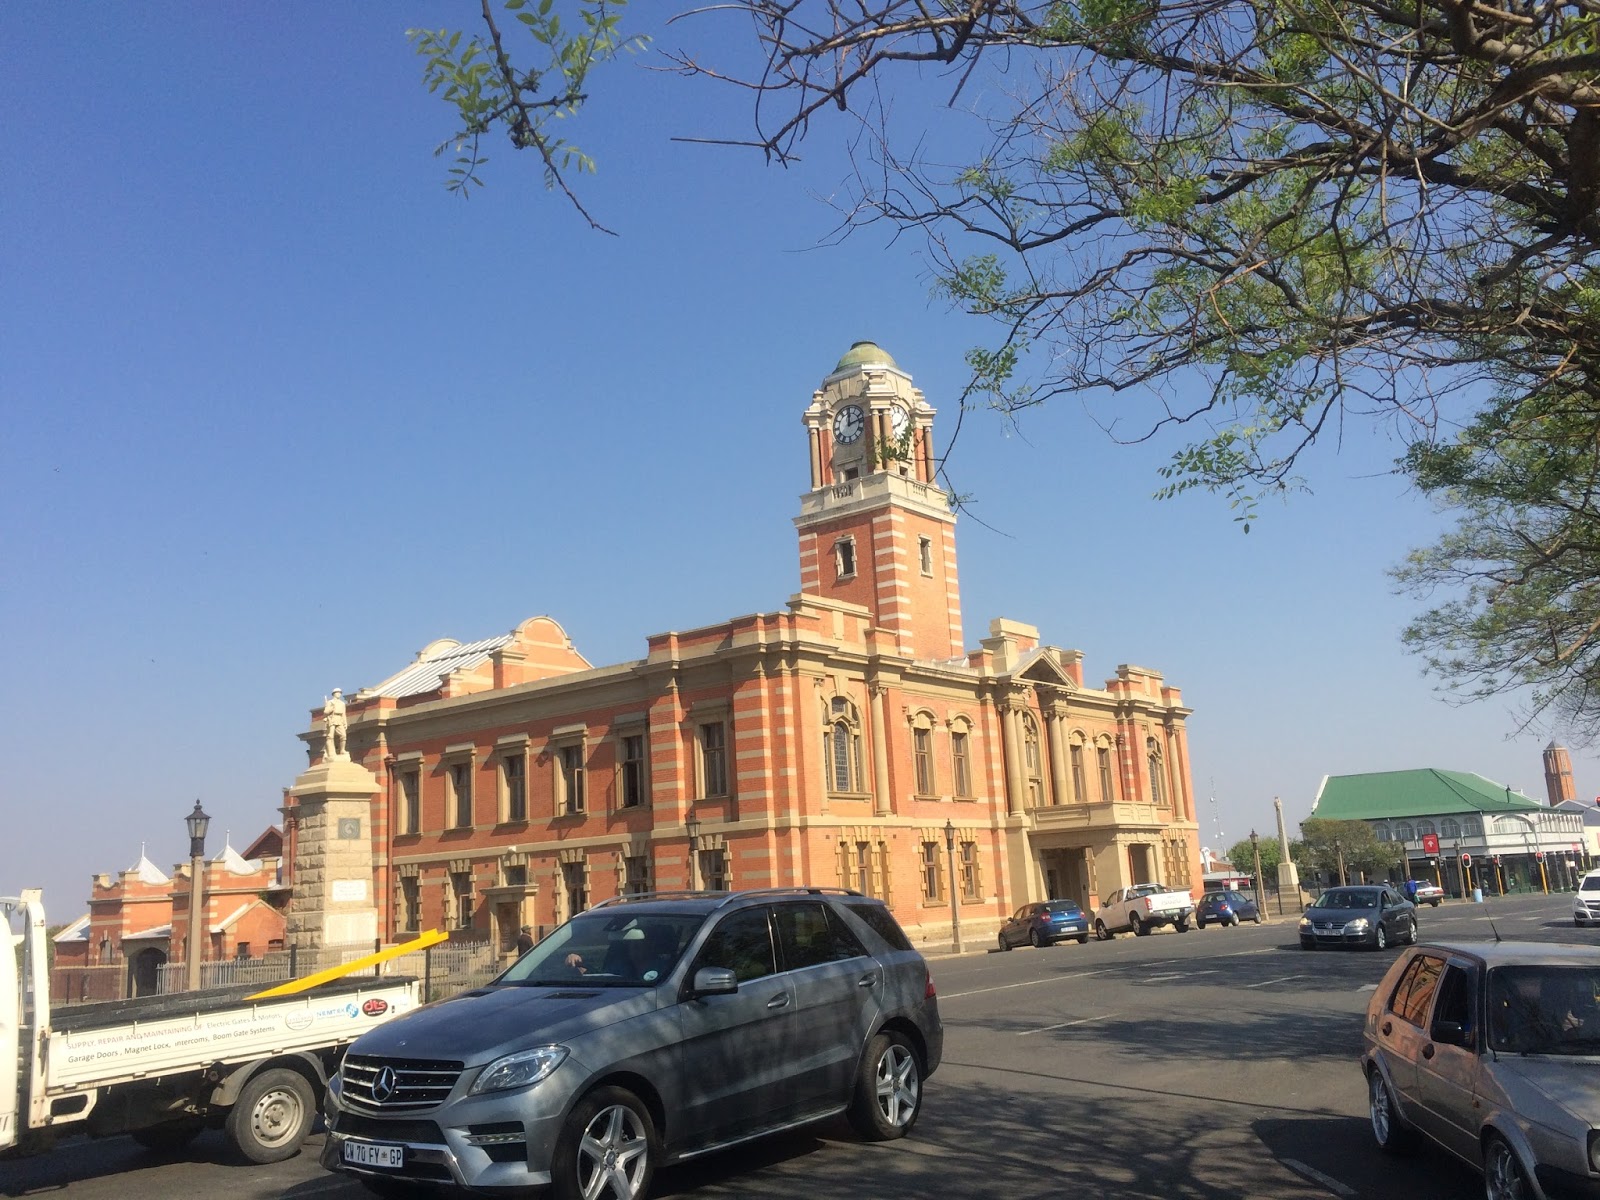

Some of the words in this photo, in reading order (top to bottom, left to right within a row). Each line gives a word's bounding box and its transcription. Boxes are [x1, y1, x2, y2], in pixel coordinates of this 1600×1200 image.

[363, 1000, 386, 1011] dts
[98, 1036, 123, 1045] REPAIR
[143, 1025, 192, 1038] MAINTAINING
[207, 1020, 231, 1028] Electric
[232, 1017, 250, 1025] Gates
[68, 1055, 95, 1064] Garage
[125, 1045, 152, 1055] Magnet
[213, 1033, 232, 1041] Boom
[233, 1030, 249, 1038] Gate
[250, 1026, 276, 1036] Systems
[357, 1145, 366, 1162] 70
[369, 1147, 380, 1163] FY
[390, 1149, 402, 1165] GP
